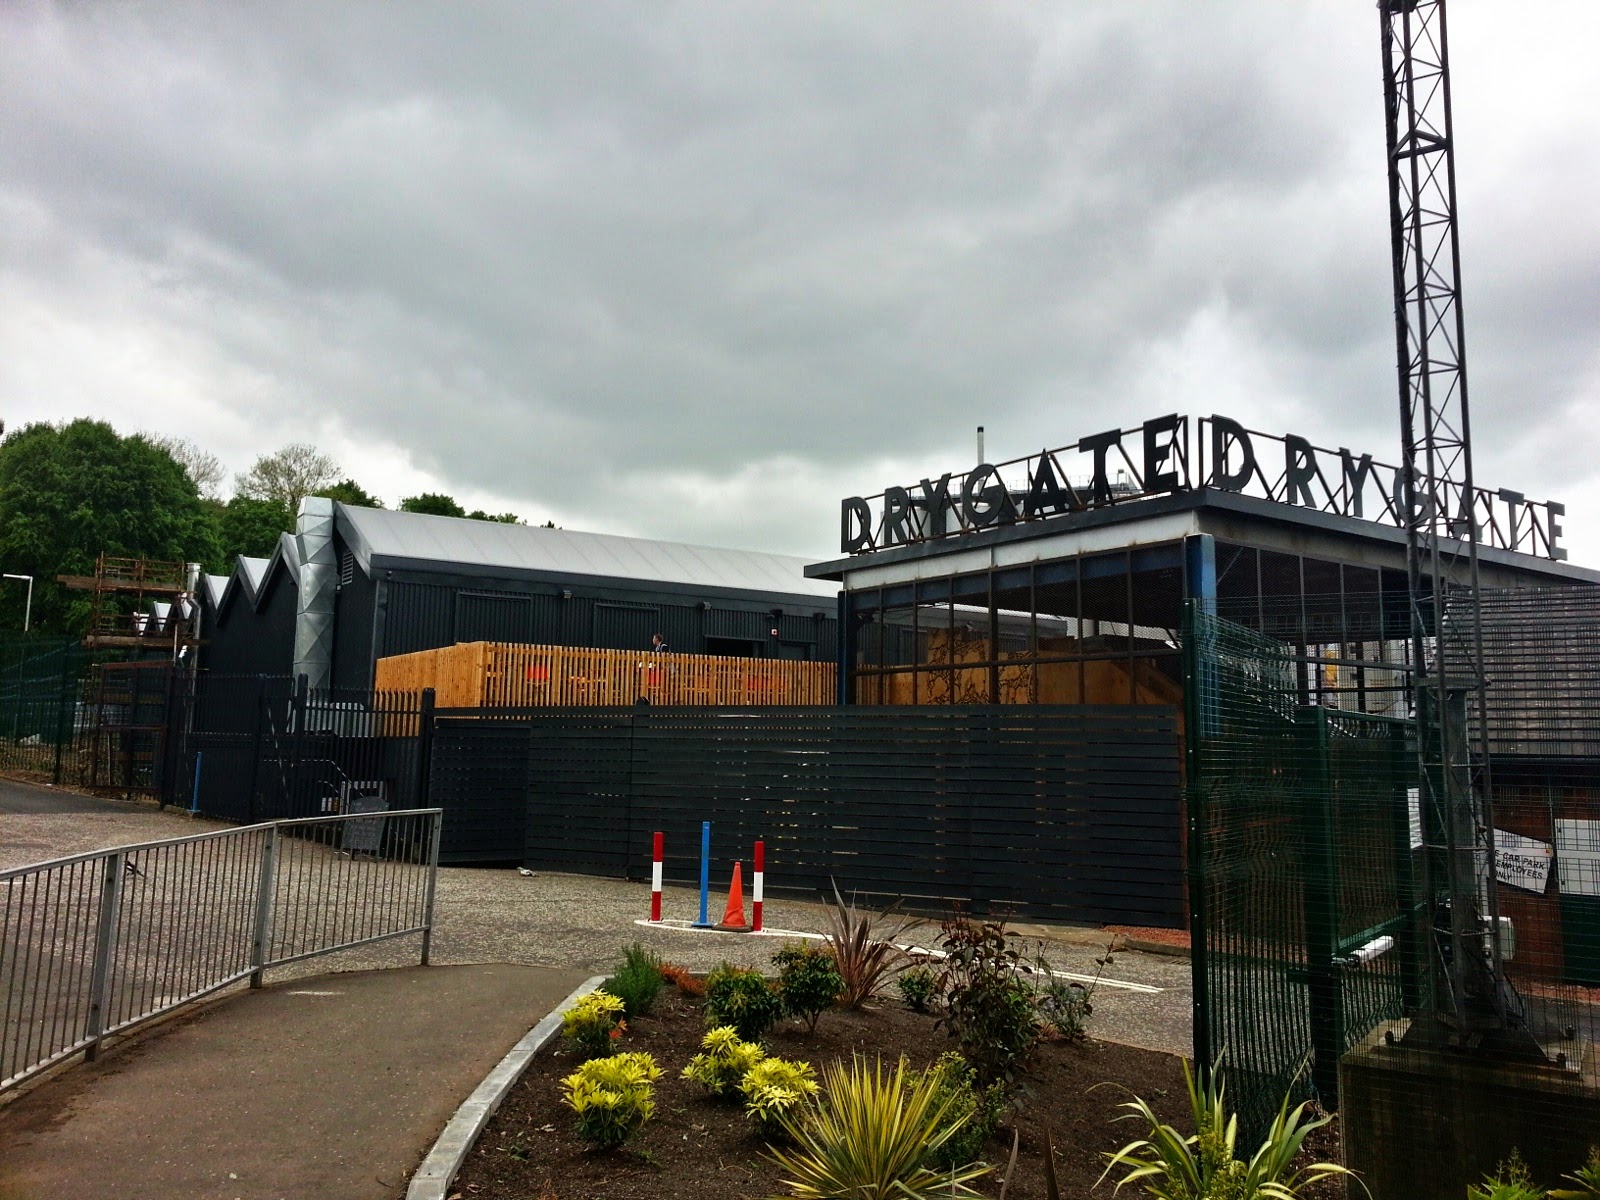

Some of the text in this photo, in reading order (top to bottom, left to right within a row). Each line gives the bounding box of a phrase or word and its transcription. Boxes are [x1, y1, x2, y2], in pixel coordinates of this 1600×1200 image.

[841, 413, 1178, 553] DRYGATE
[1496, 860, 1543, 879] EMPLOYEES
[1503, 852, 1520, 863] CAR
[1523, 857, 1545, 870] PARK
[1496, 870, 1512, 880] NLY
